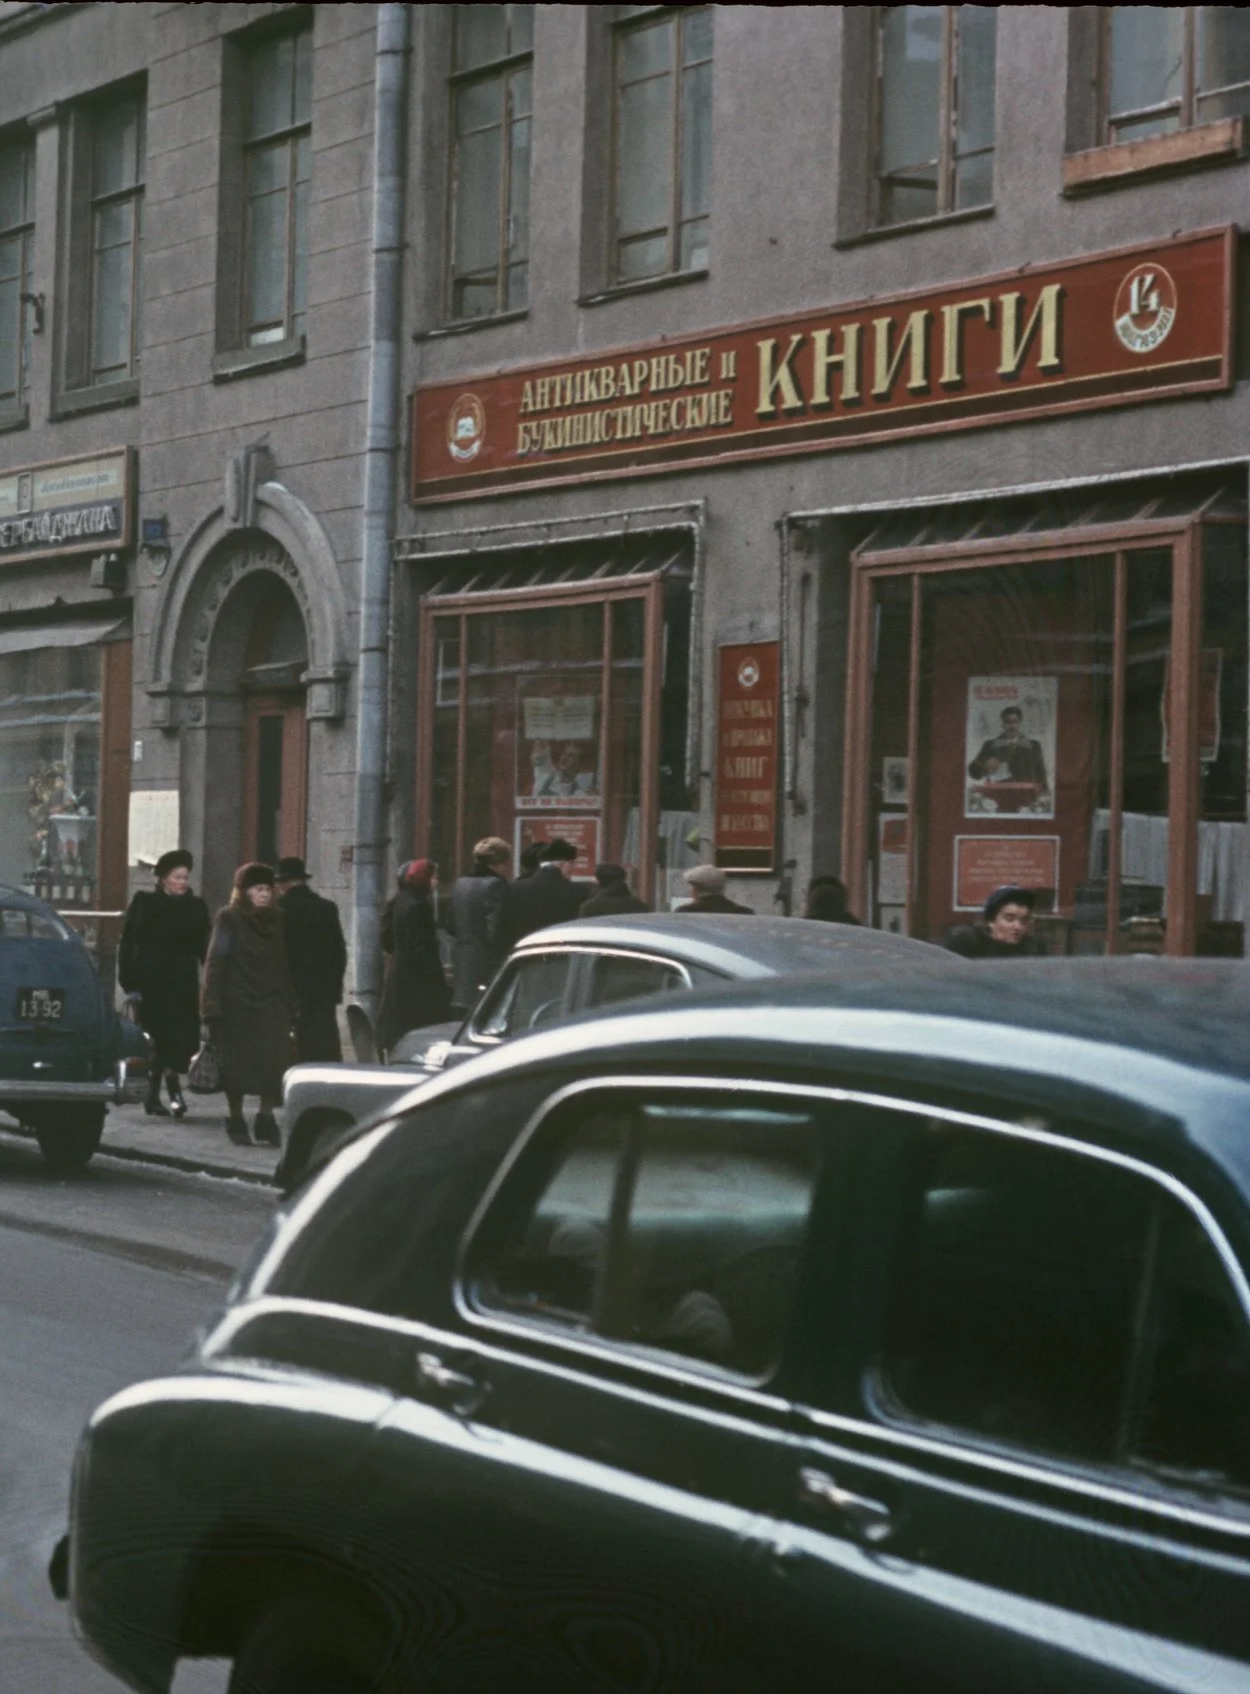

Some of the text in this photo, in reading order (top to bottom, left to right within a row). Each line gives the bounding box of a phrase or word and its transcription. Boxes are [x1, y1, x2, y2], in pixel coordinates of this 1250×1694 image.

[519, 347, 711, 413] АНТИКВАРНЫЕ
[754, 283, 1062, 413] КНИГИ
[516, 389, 734, 454] БУКИНИСТИЧЕСКИЕ
